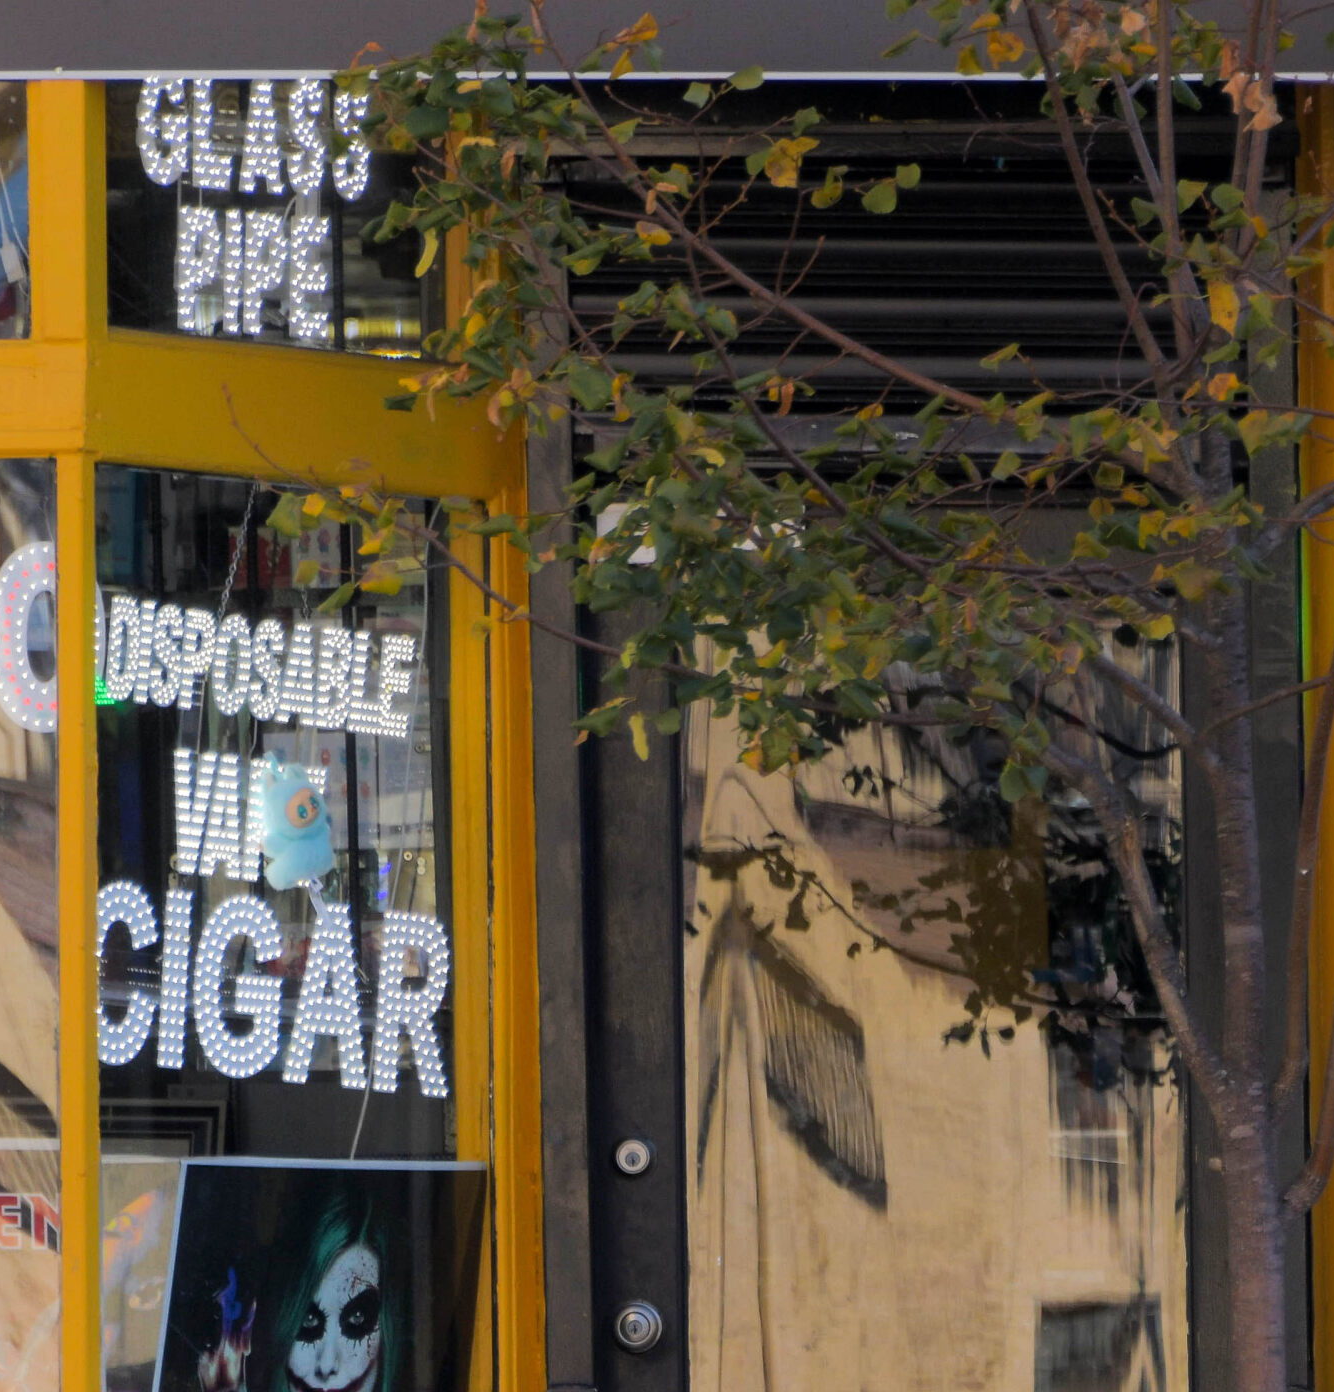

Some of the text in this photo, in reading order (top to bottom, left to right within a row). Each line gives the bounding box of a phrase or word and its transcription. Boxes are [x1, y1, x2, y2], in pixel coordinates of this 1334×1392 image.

[136, 75, 368, 200] GLASS
[174, 205, 330, 338] PIPE
[107, 594, 417, 738] DISPOSABLE
[95, 880, 451, 1097] CIGAR
